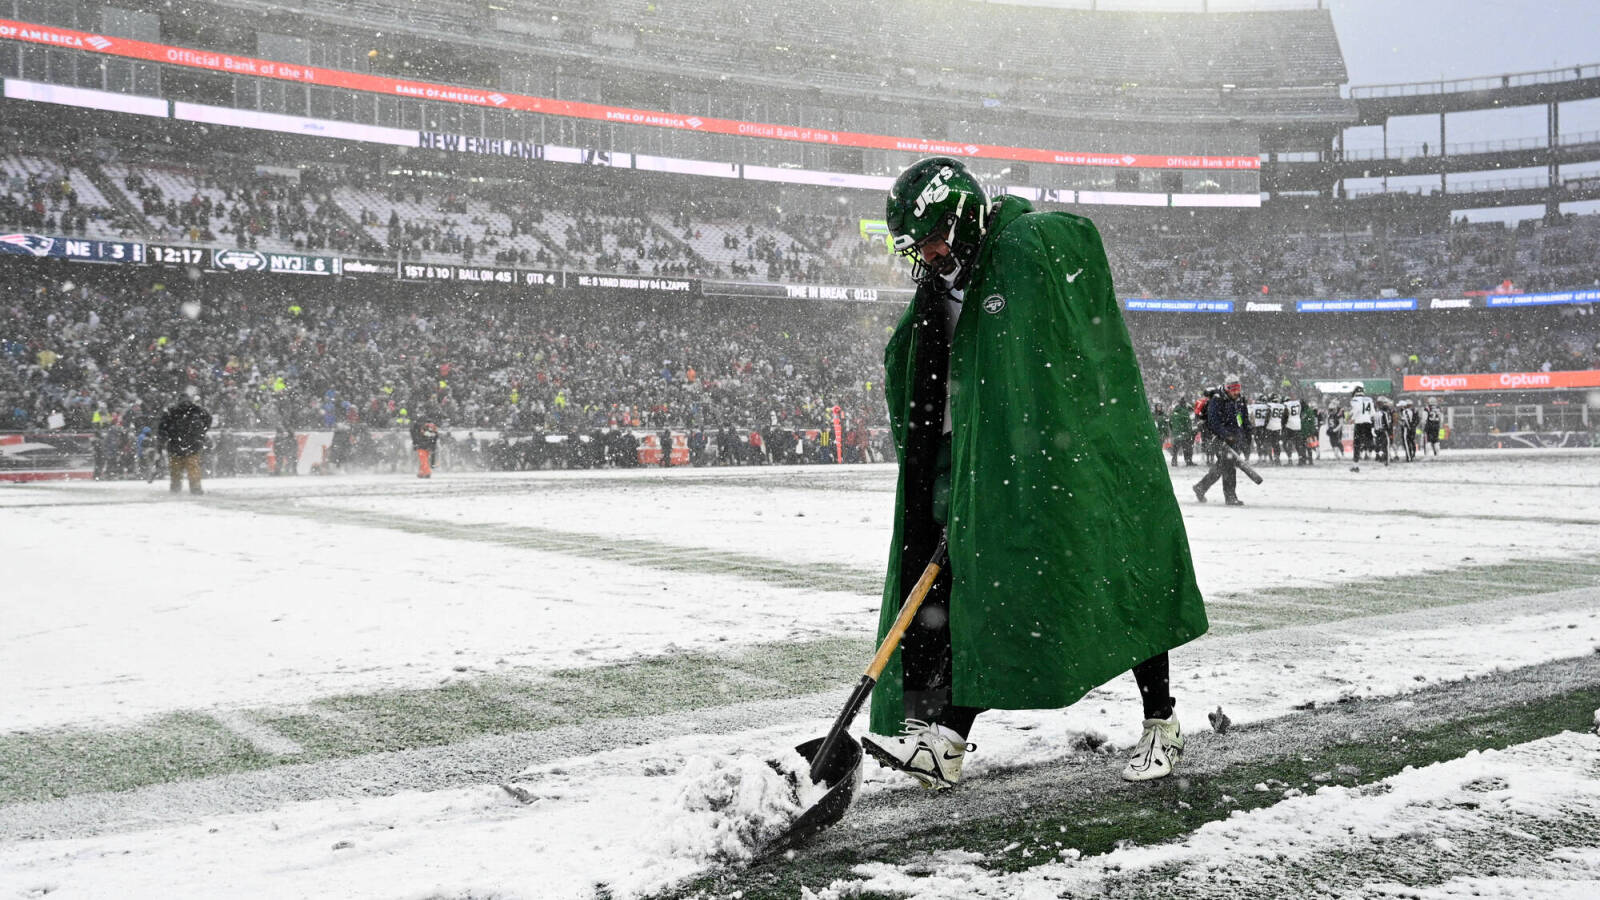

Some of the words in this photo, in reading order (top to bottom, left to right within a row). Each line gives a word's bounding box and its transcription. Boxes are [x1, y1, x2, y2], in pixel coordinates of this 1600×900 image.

[0, 26, 17, 35] OF
[20, 29, 83, 46] AMERICA
[167, 49, 219, 67] Official
[223, 57, 257, 73] Bank
[260, 64, 275, 74] of
[279, 66, 300, 78] the
[304, 69, 314, 80] N
[395, 85, 424, 96] BANK
[426, 88, 440, 97] OF
[440, 91, 487, 103] AMERICA
[606, 111, 631, 121] BANK
[632, 113, 644, 122] OF
[645, 115, 685, 127] AMERICA
[738, 123, 774, 136] Official
[776, 127, 799, 138] Bank
[801, 131, 811, 140] of
[814, 132, 829, 141] the
[418, 131, 460, 151] NEW
[465, 136, 545, 161] ENGLAND
[896, 141, 917, 149] BANK
[930, 144, 963, 153] AMERICA
[1076, 155, 1085, 163] OF
[1087, 157, 1120, 165] AMERICA
[1167, 157, 1200, 167] Official
[1202, 158, 1223, 167] Bank
[1225, 158, 1235, 167] of
[1238, 159, 1252, 167] the
[913, 166, 954, 218] JETS
[65, 240, 91, 256] NE
[111, 244, 125, 259] 3
[151, 247, 202, 264] 12:17
[270, 255, 302, 270] NYJ
[314, 258, 325, 272] 6
[404, 265, 426, 278] 1ST
[426, 266, 435, 278] &
[435, 267, 450, 279] 10
[458, 268, 480, 281] BALL
[480, 270, 494, 282] ON
[495, 271, 512, 283] 45
[526, 272, 544, 285] QTR
[545, 274, 555, 285] 4
[599, 277, 619, 287] YARD
[619, 278, 639, 289] RUSH
[639, 279, 650, 290] BY
[785, 285, 807, 298] TIME
[808, 286, 818, 298] IN
[820, 286, 849, 300] BREAK
[854, 288, 878, 301] 01:13
[1419, 375, 1467, 390] Optum
[1500, 373, 1549, 388] Optum
[1362, 402, 1371, 415] 14
